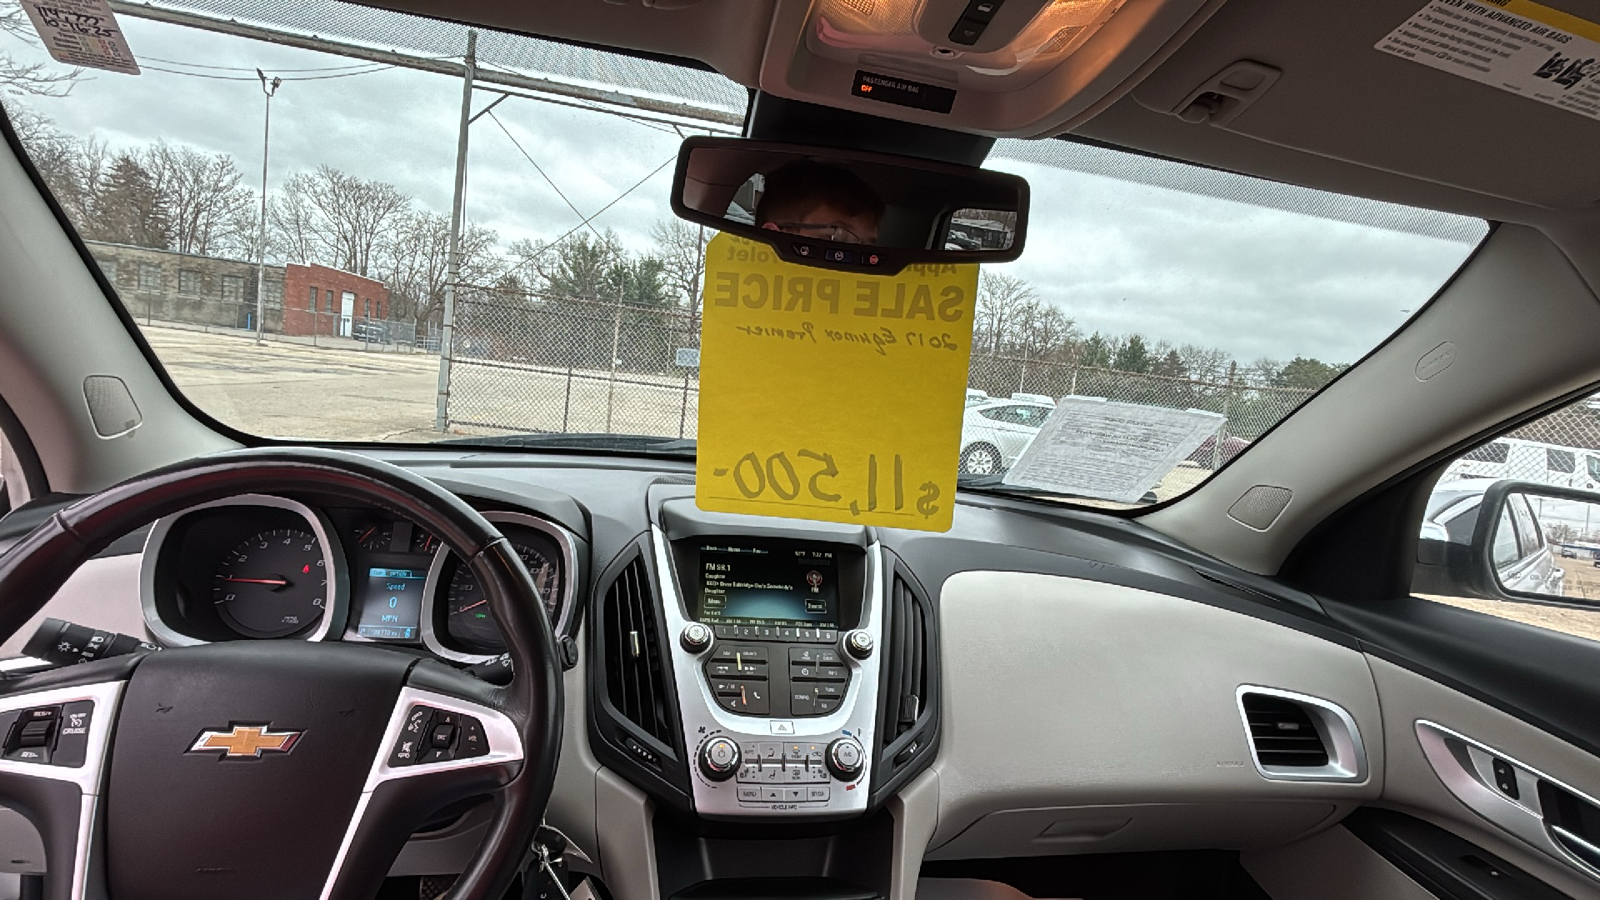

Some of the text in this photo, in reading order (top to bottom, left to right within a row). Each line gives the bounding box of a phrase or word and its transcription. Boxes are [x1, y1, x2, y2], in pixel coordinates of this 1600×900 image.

[1485, 9, 1533, 31] ADVANCED
[1532, 25, 1547, 37] AIR
[1547, 31, 1573, 44] BAGS
[861, 84, 873, 93] OFF
[863, 76, 896, 89] PASSENGER
[907, 85, 919, 94] BAG
[303, 544, 312, 552] 5
[316, 559, 324, 567] 6
[705, 563, 715, 571] FM
[386, 582, 406, 591] Speed
[388, 596, 398, 609] 0
[381, 614, 399, 622] MPH
[62, 727, 87, 736] CRUISE
